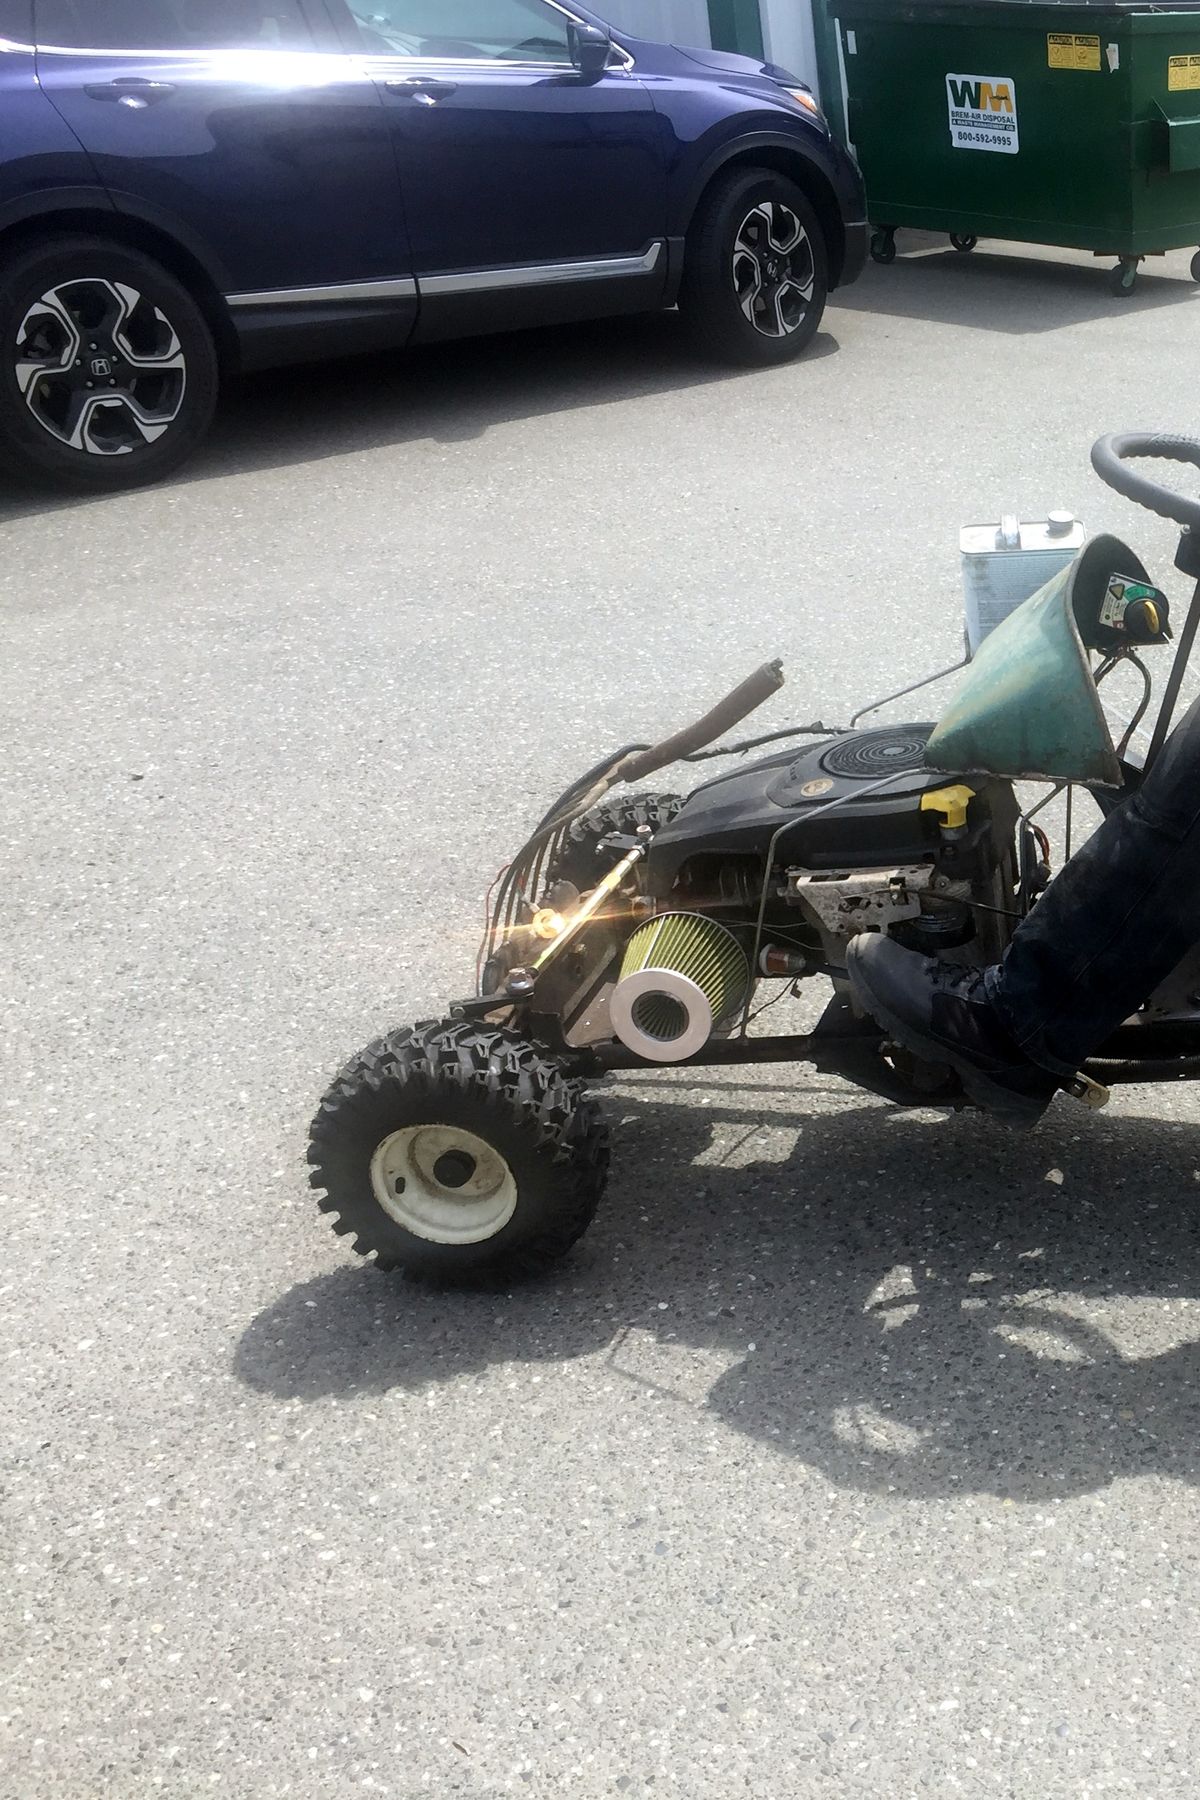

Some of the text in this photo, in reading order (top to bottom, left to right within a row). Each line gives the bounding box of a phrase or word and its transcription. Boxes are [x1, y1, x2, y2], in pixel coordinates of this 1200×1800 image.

[948, 80, 1013, 113] WM
[983, 114, 1015, 124] DISPOSAL
[958, 131, 1012, 146] 800-592-9995
